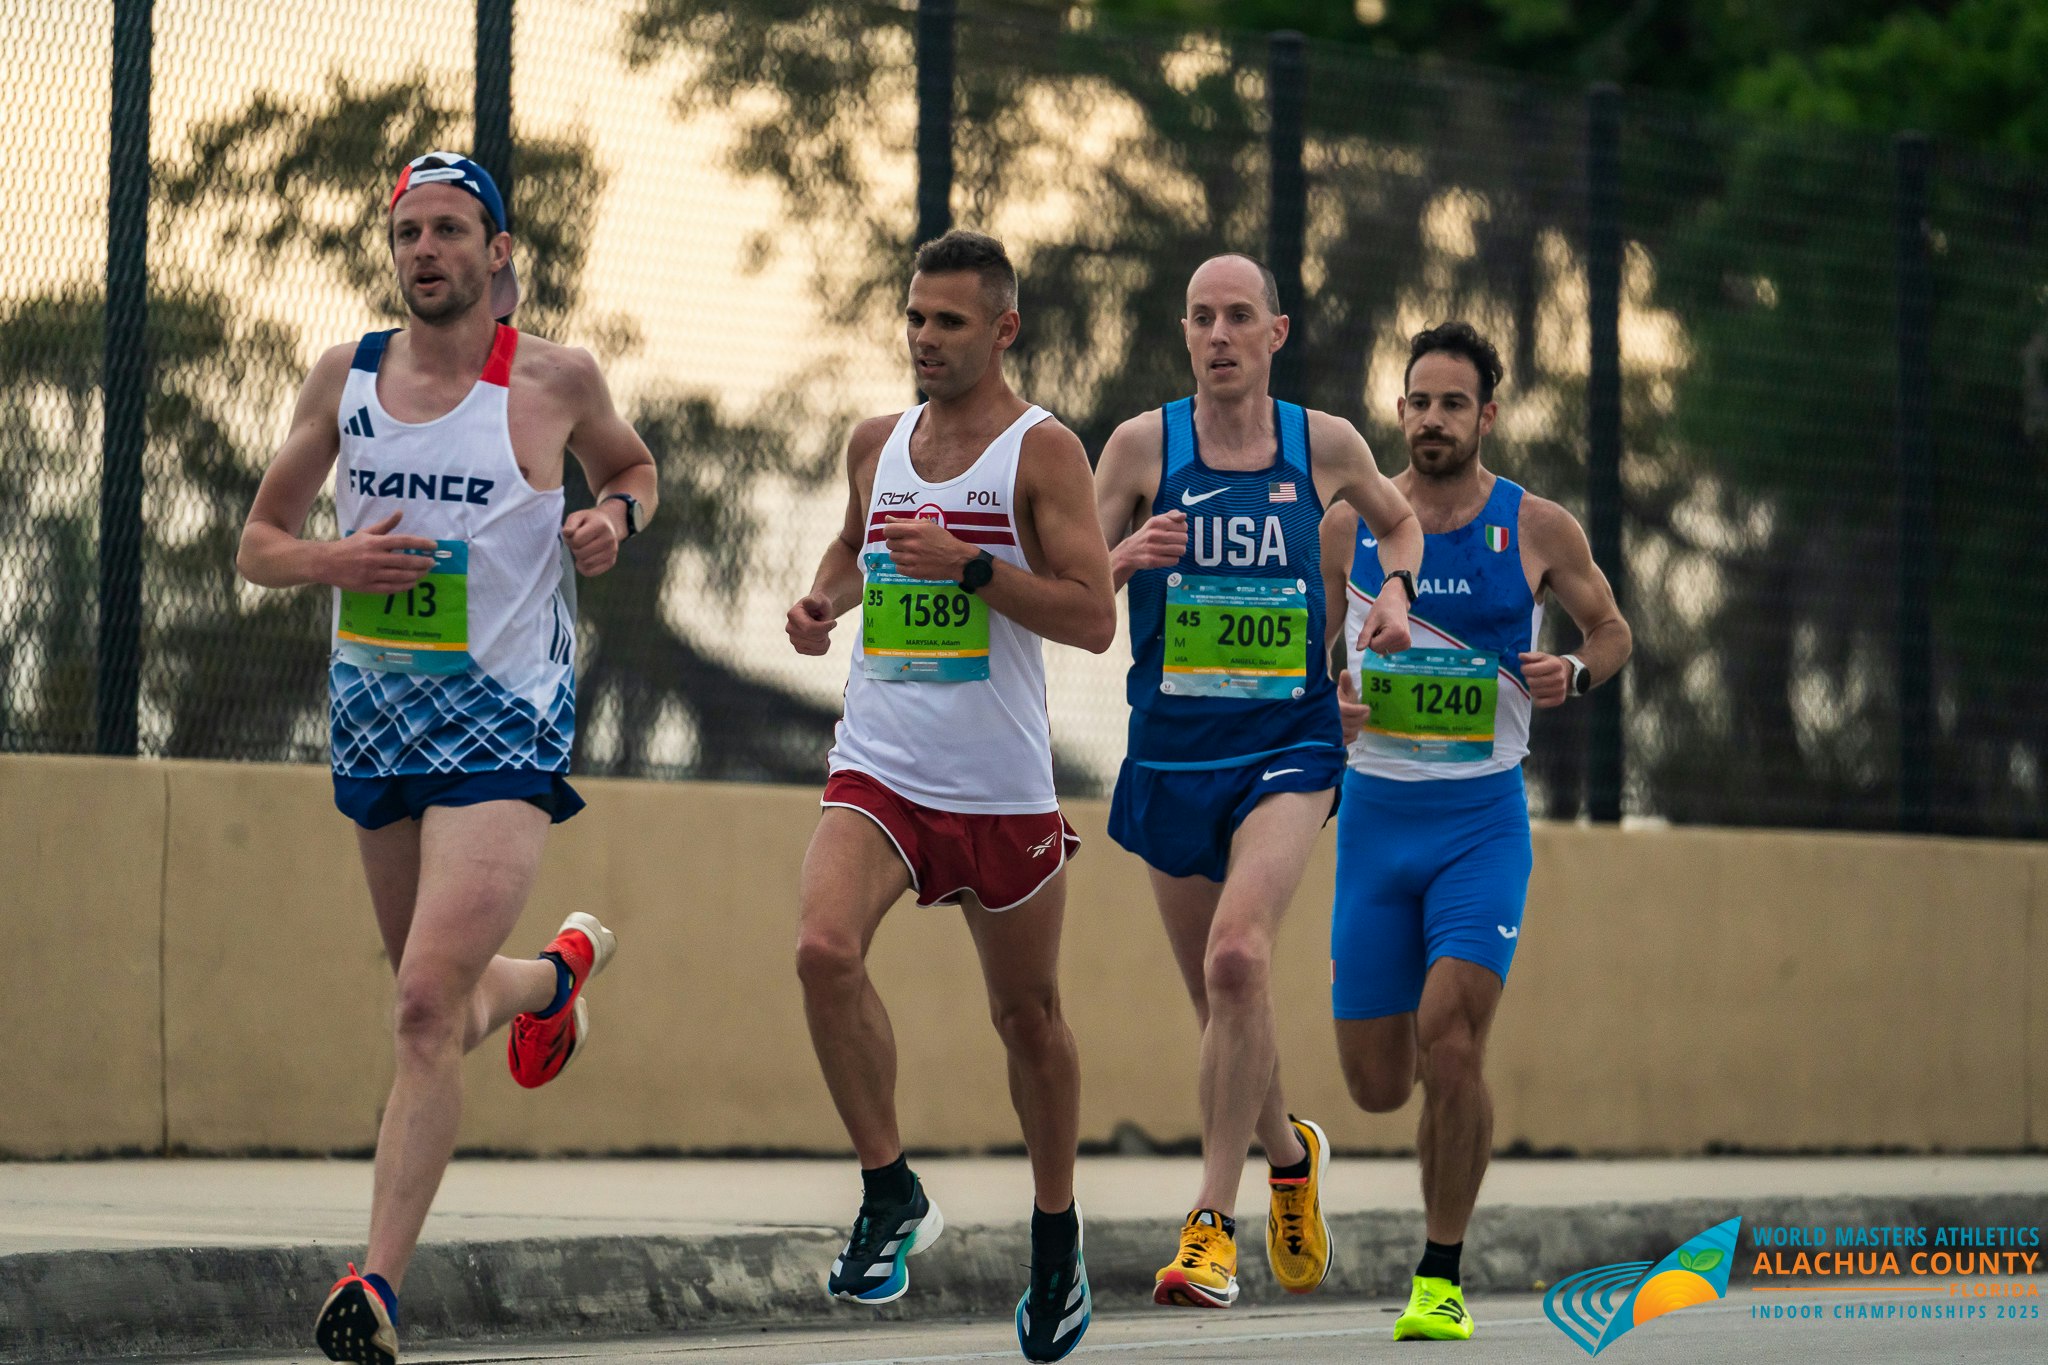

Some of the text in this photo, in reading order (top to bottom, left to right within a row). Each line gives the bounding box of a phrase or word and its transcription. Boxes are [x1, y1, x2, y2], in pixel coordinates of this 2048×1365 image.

[349, 469, 495, 506] FRANCE
[967, 491, 1001, 506] POL
[1194, 516, 1288, 567] USA
[1417, 578, 1472, 595] ALIA
[868, 589, 884, 607] 35
[899, 593, 970, 628] 1589
[1176, 611, 1201, 627] 45
[866, 617, 874, 628] M
[1217, 613, 1292, 648] 2005
[905, 639, 940, 647] MARYSIAK,
[1174, 637, 1186, 648] M
[1174, 655, 1189, 663] USA
[1258, 658, 1277, 666] David
[1370, 677, 1393, 694] 35
[1410, 682, 1483, 716] 1240
